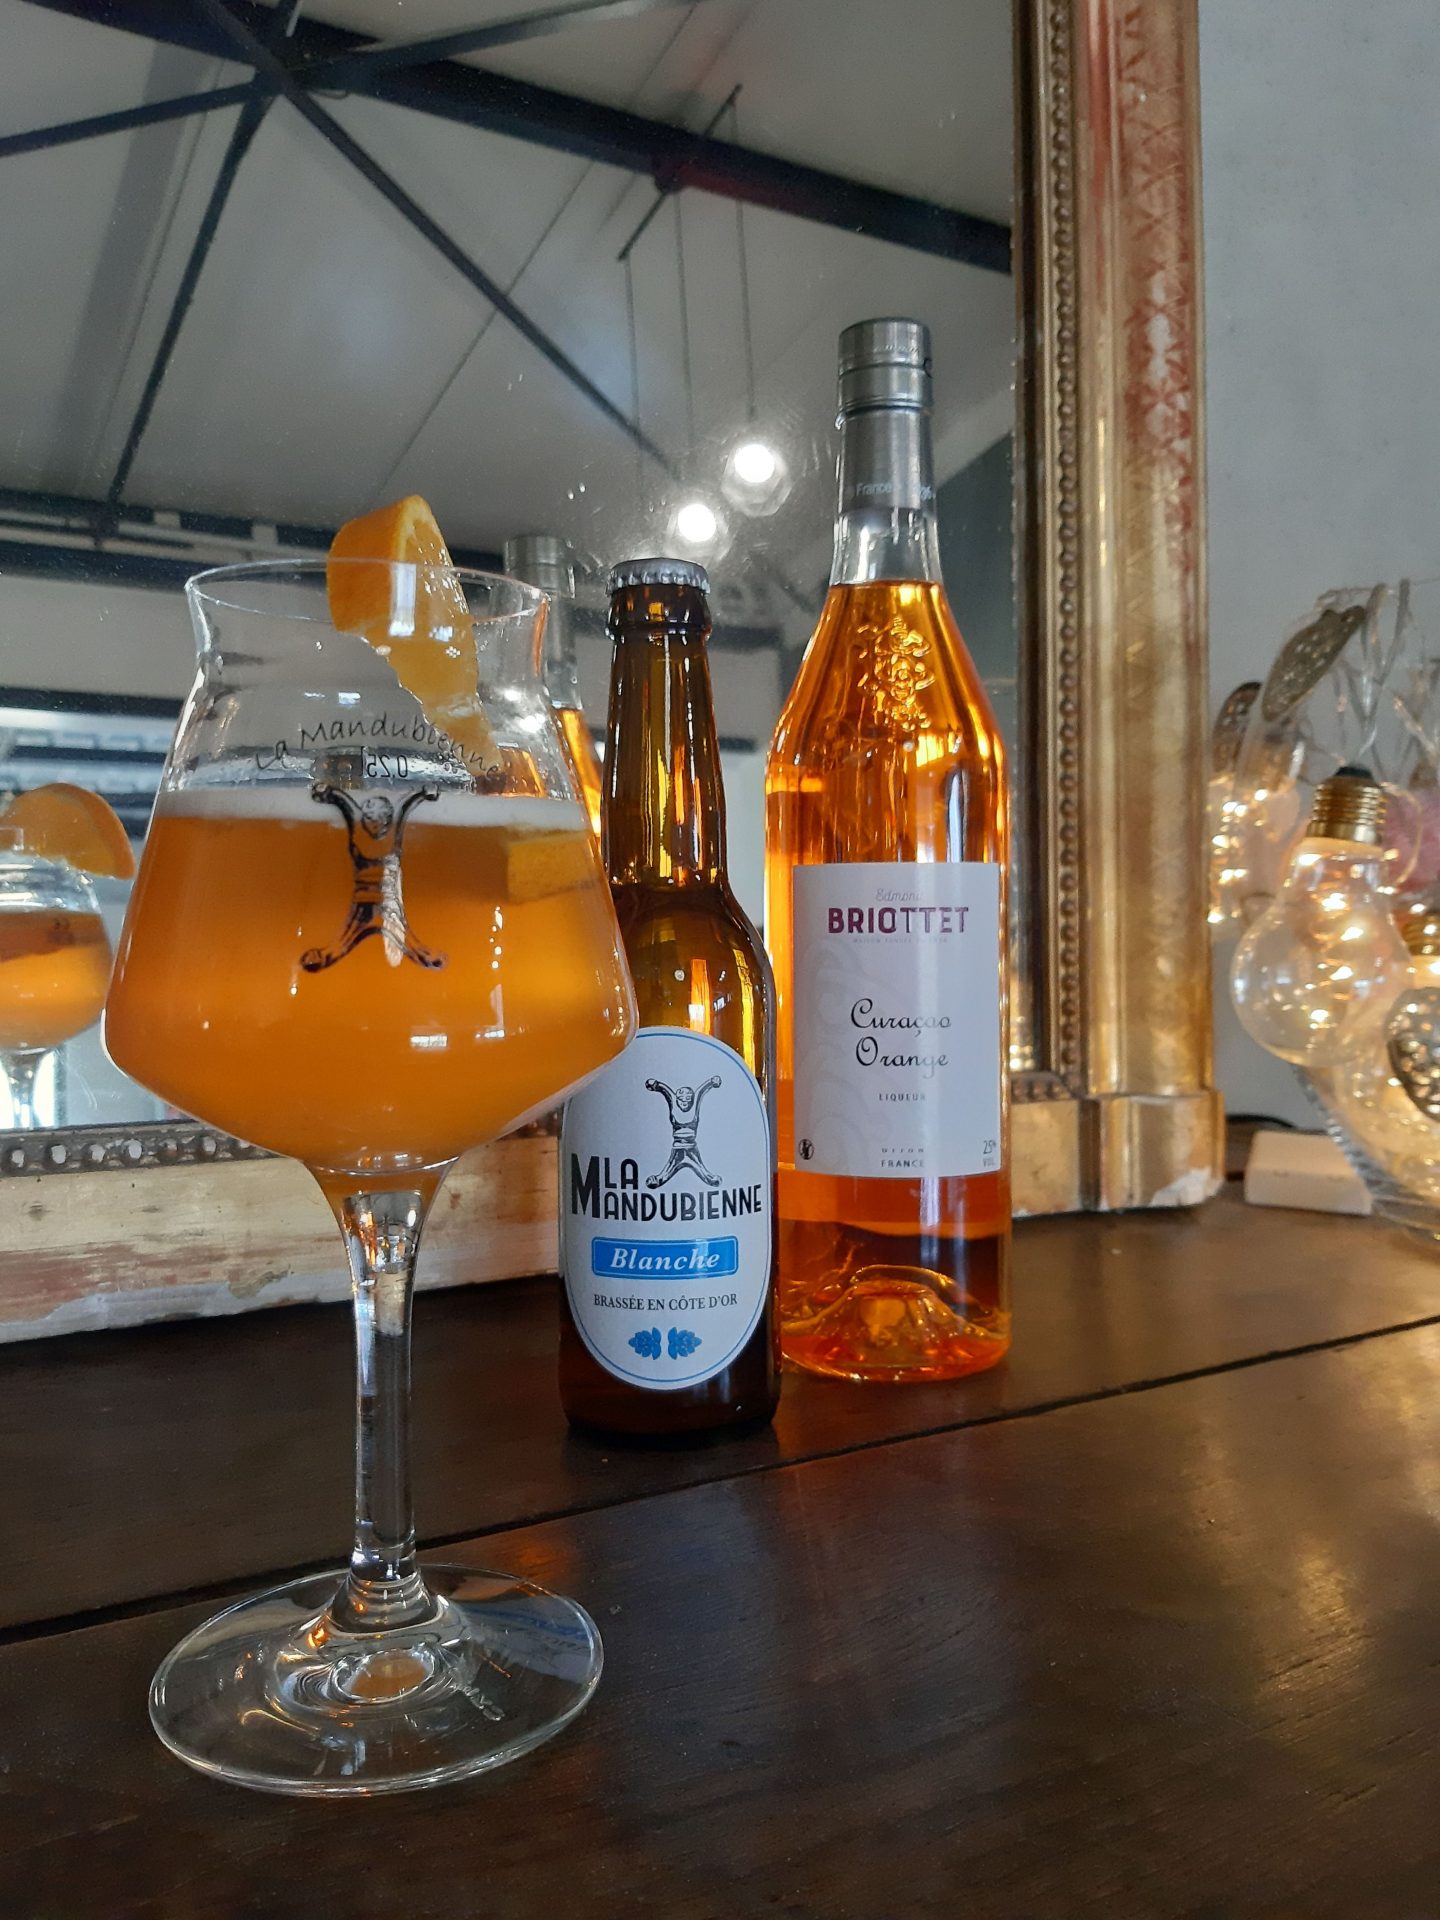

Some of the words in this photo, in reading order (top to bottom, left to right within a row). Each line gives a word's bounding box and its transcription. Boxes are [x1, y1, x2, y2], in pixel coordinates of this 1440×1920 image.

[828, 906, 969, 934] BRIOTTET
[850, 998, 952, 1038] Curaçao
[855, 1036, 949, 1079] Orange
[604, 1157, 639, 1190] LA
[881, 1160, 924, 1168] FRANCE
[570, 1152, 763, 1222] MANDUBIENNE
[610, 1247, 720, 1271] Blanche
[593, 1294, 643, 1311] BRASSÉE
[647, 1298, 665, 1311] EN
[668, 1295, 705, 1311] CÔTE
[708, 1293, 738, 1304] D'OR
